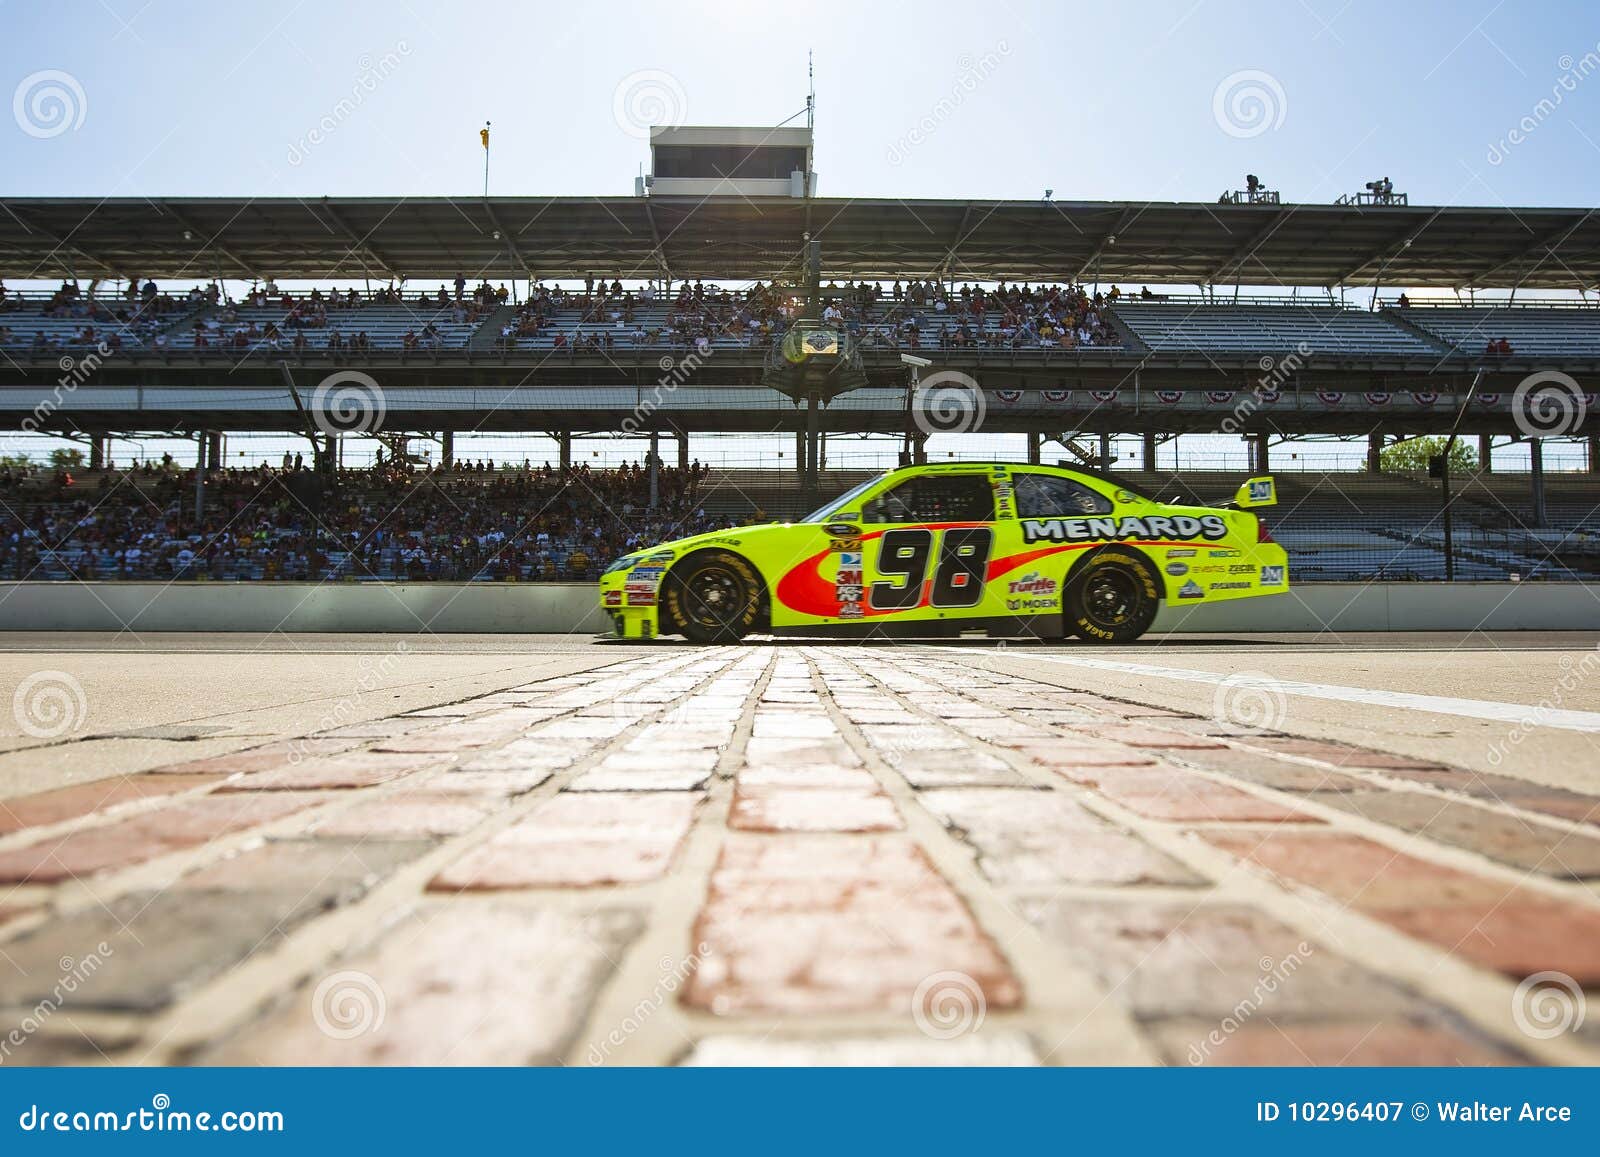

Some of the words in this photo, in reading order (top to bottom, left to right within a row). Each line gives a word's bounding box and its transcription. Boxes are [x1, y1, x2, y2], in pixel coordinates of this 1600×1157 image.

[1022, 515, 1228, 544] MENARDS
[836, 570, 863, 585] 3M
[869, 527, 994, 610] 98
[1008, 577, 1056, 594] Turtle
[1023, 599, 1058, 608] MOEN
[1078, 616, 1115, 640] EAGLE
